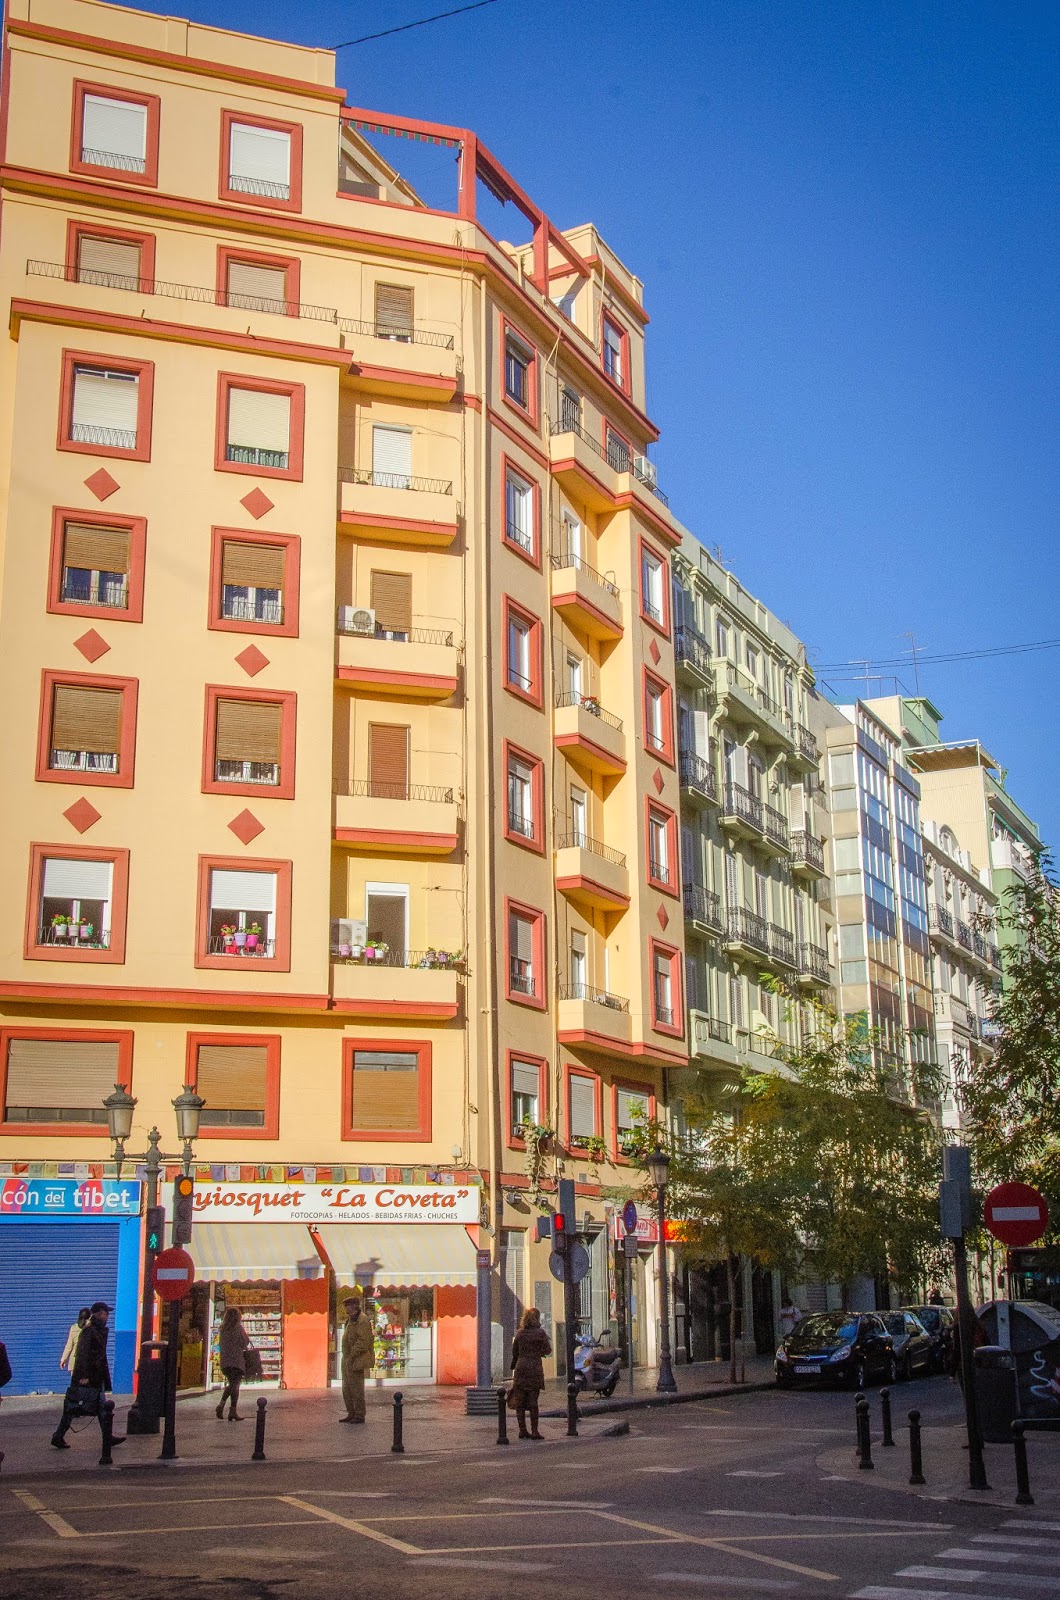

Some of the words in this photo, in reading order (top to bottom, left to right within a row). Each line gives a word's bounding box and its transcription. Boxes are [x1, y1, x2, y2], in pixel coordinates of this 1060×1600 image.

[0, 1184, 39, 1206] cón
[44, 1190, 65, 1204] del
[73, 1186, 131, 1208] tibet
[191, 1186, 306, 1216] uiosquet
[290, 1211, 334, 1220] FOTOCOPIAS
[338, 1212, 370, 1220] HELADOS
[375, 1212, 403, 1220] BEBIDAS
[403, 1212, 423, 1220] FRIAS
[427, 1212, 459, 1220] CHUCHES
